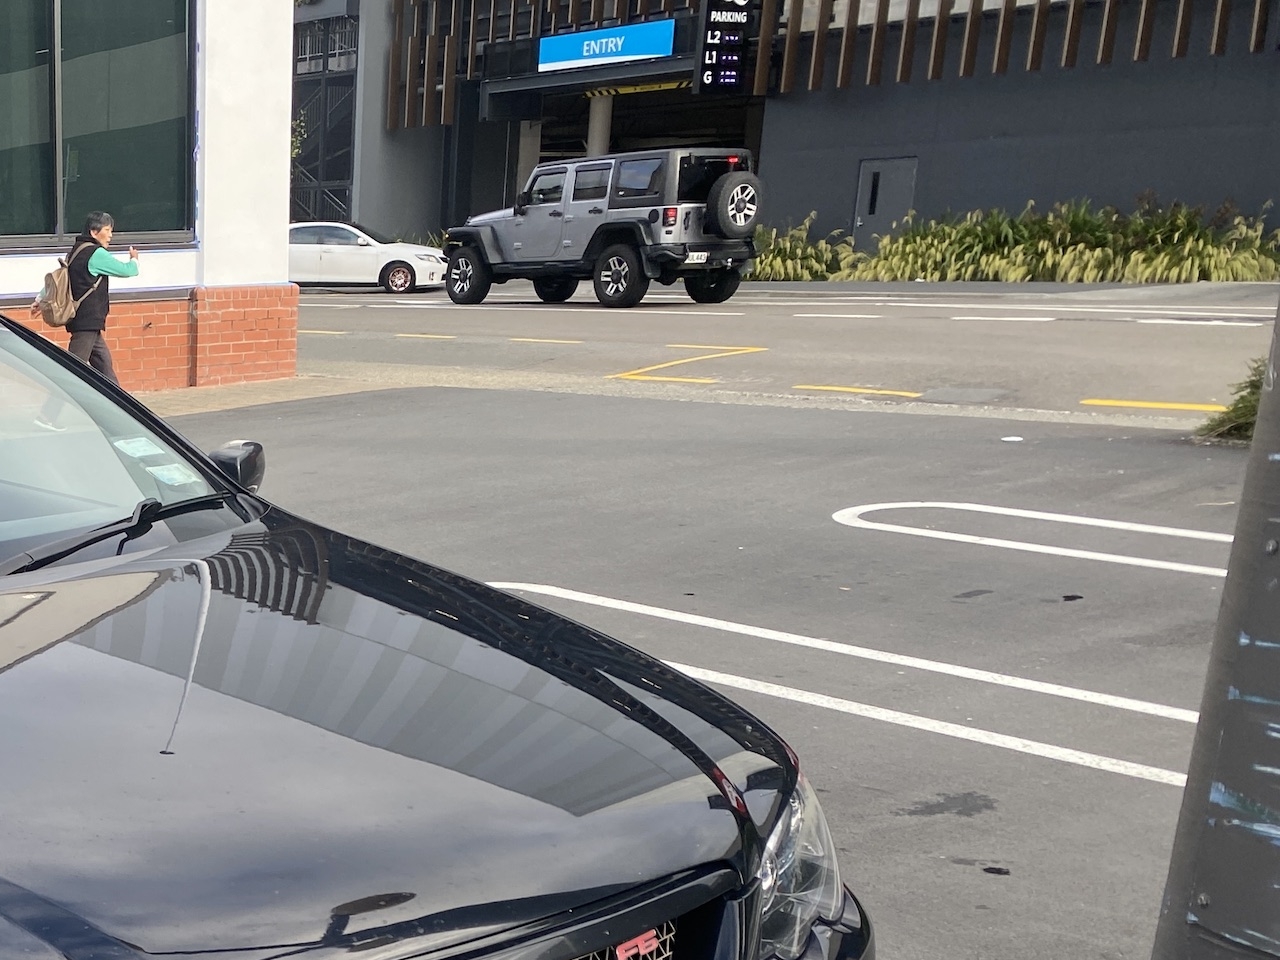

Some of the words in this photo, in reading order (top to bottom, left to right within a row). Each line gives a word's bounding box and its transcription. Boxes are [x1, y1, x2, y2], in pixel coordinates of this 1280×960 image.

[710, 11, 747, 24] PARKING
[707, 31, 721, 44] L2
[583, 36, 625, 57] ENTRY
[705, 51, 717, 64] L1
[703, 71, 712, 84] G
